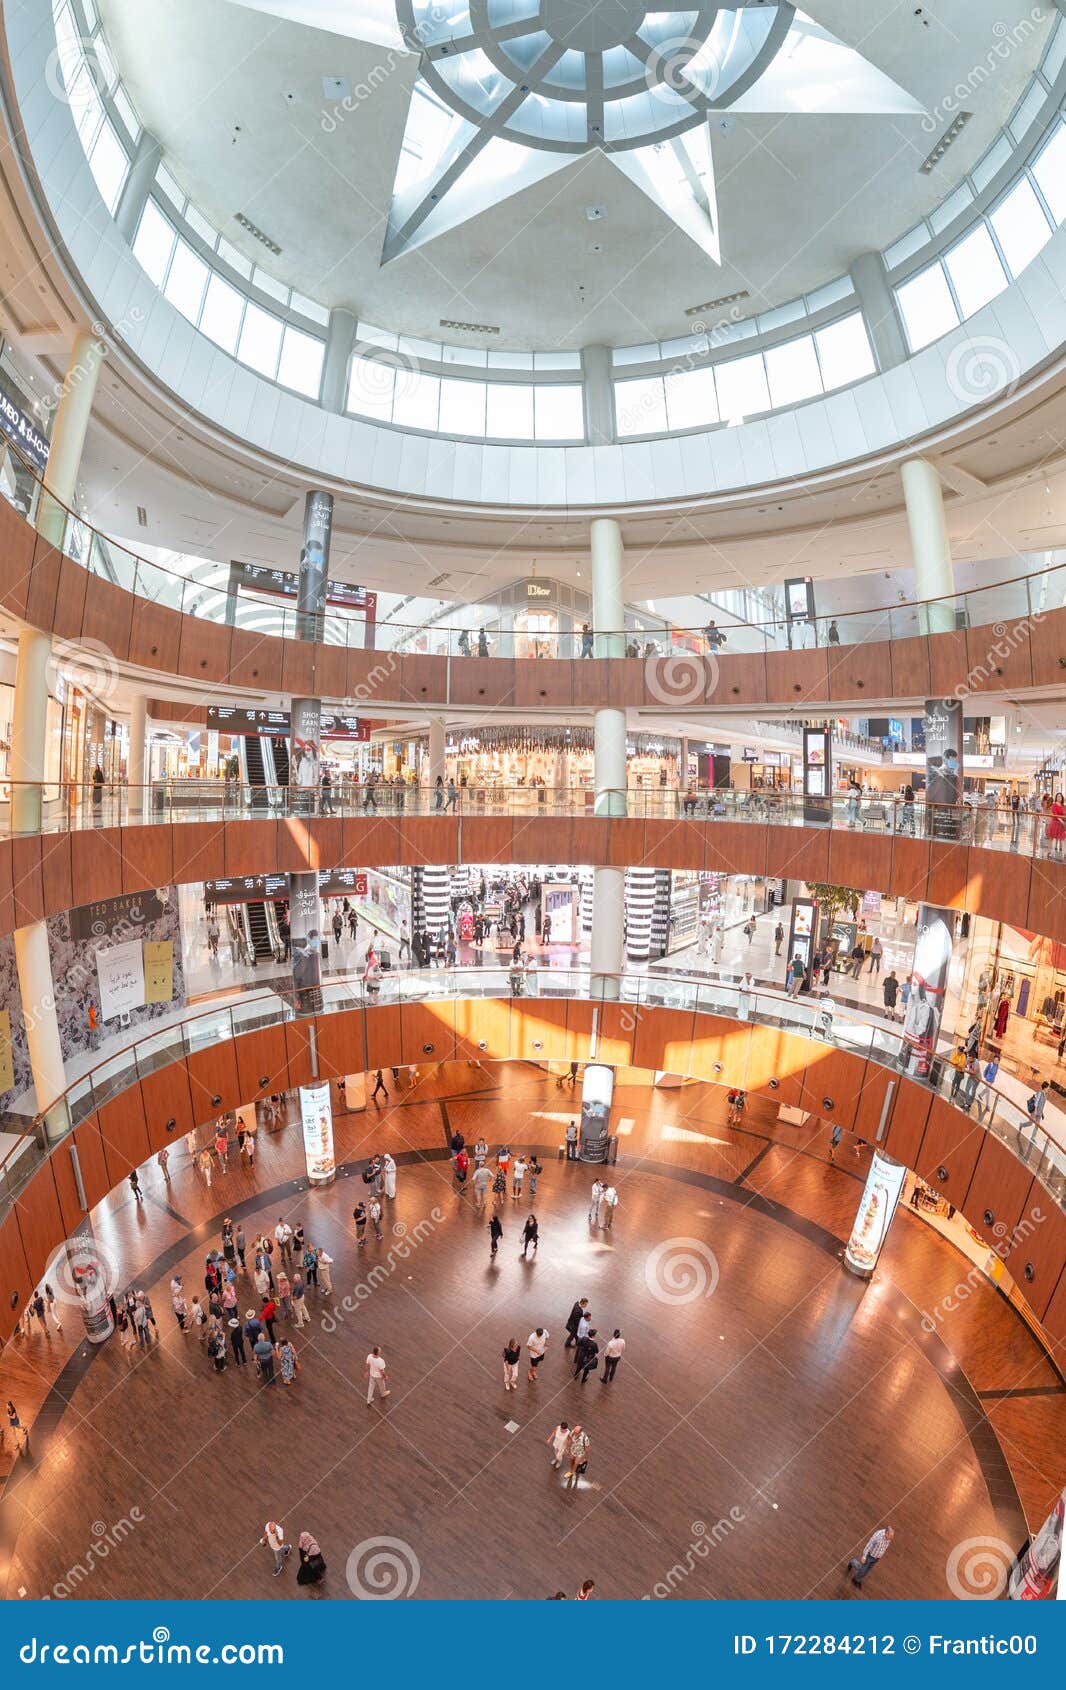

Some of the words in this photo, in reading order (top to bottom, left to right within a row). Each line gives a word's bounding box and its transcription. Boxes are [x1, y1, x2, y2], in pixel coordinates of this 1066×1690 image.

[528, 584, 550, 595] Dior
[368, 597, 374, 607] 2
[356, 881, 365, 892] G
